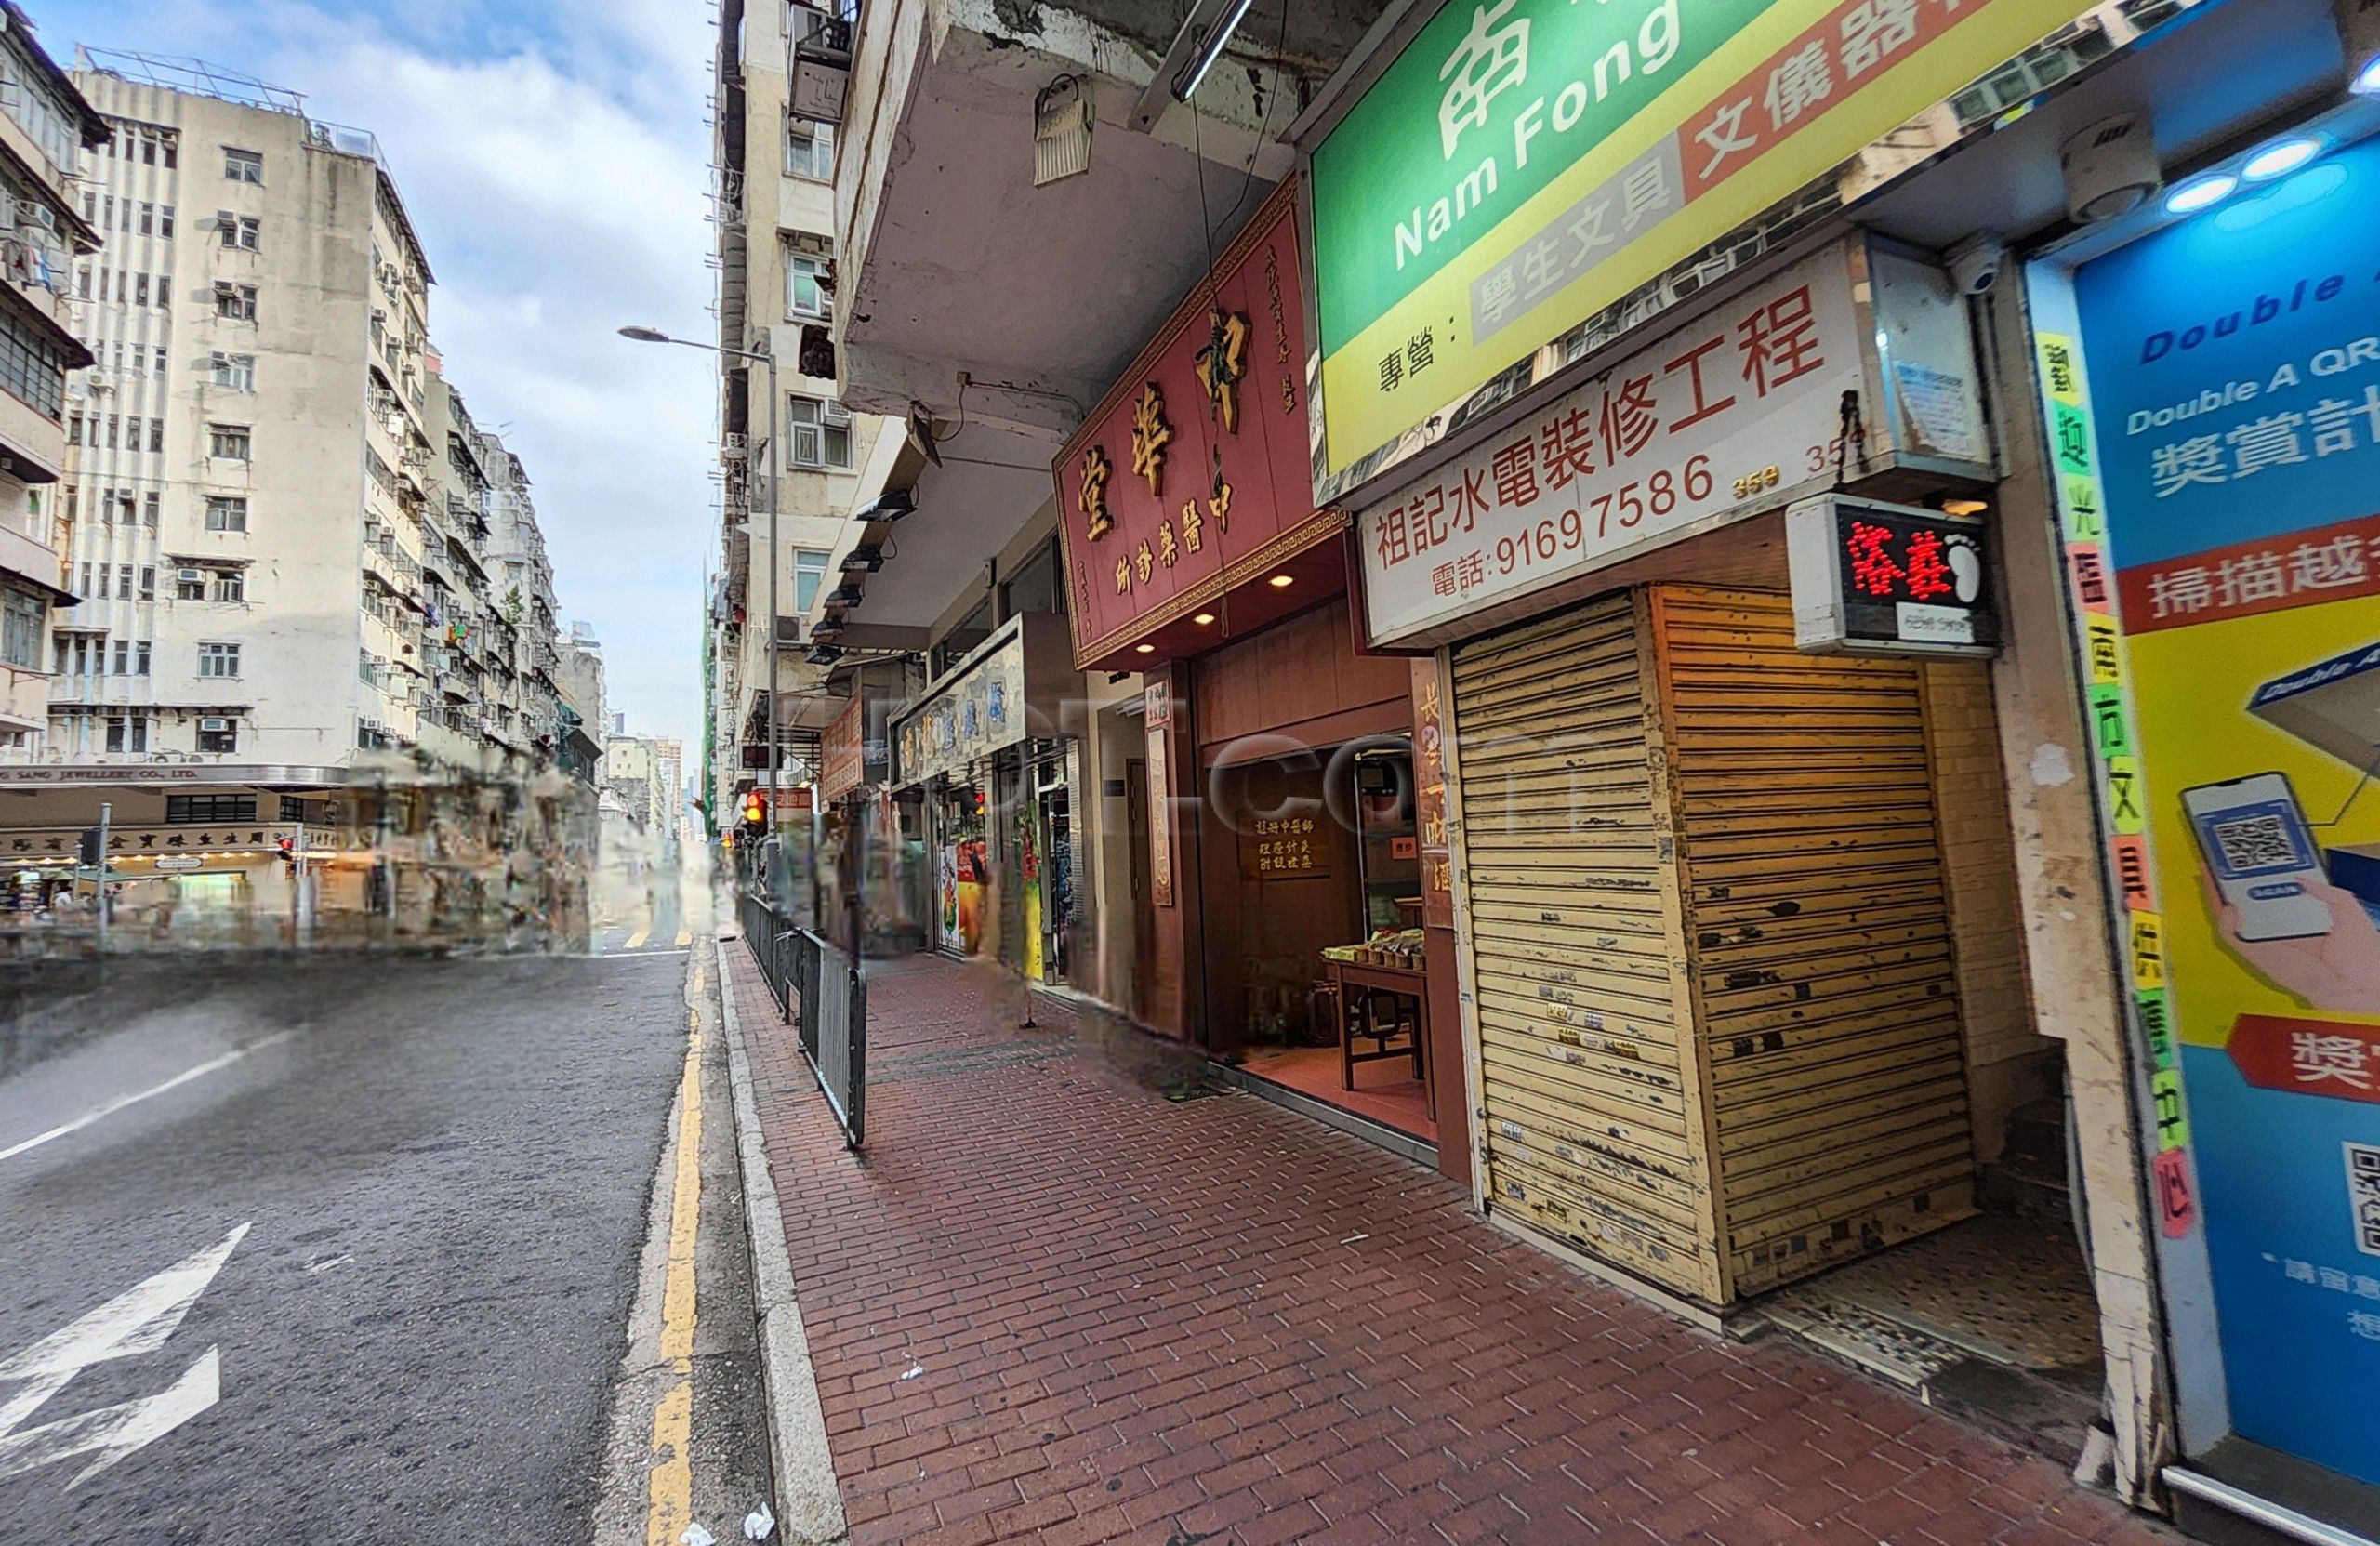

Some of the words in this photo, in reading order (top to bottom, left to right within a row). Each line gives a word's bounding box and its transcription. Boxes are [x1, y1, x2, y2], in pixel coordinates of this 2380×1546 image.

[1394, 156, 1499, 271] Nam
[1514, 0, 1682, 171] Fong
[1478, 154, 1671, 324] 學生文具
[1693, 0, 1962, 181] 文儀器
[2141, 273, 2345, 365] Double
[1376, 284, 1825, 571] 祖記水電裝修工程
[2125, 380, 2260, 437] Double
[2265, 363, 2301, 394] A
[2309, 337, 2380, 377] QR
[1732, 464, 1780, 500] 359
[2147, 534, 2380, 620] 掃描越
[60, 770, 134, 781] JEWELLERY
[2289, 1031, 2380, 1090] 獎
